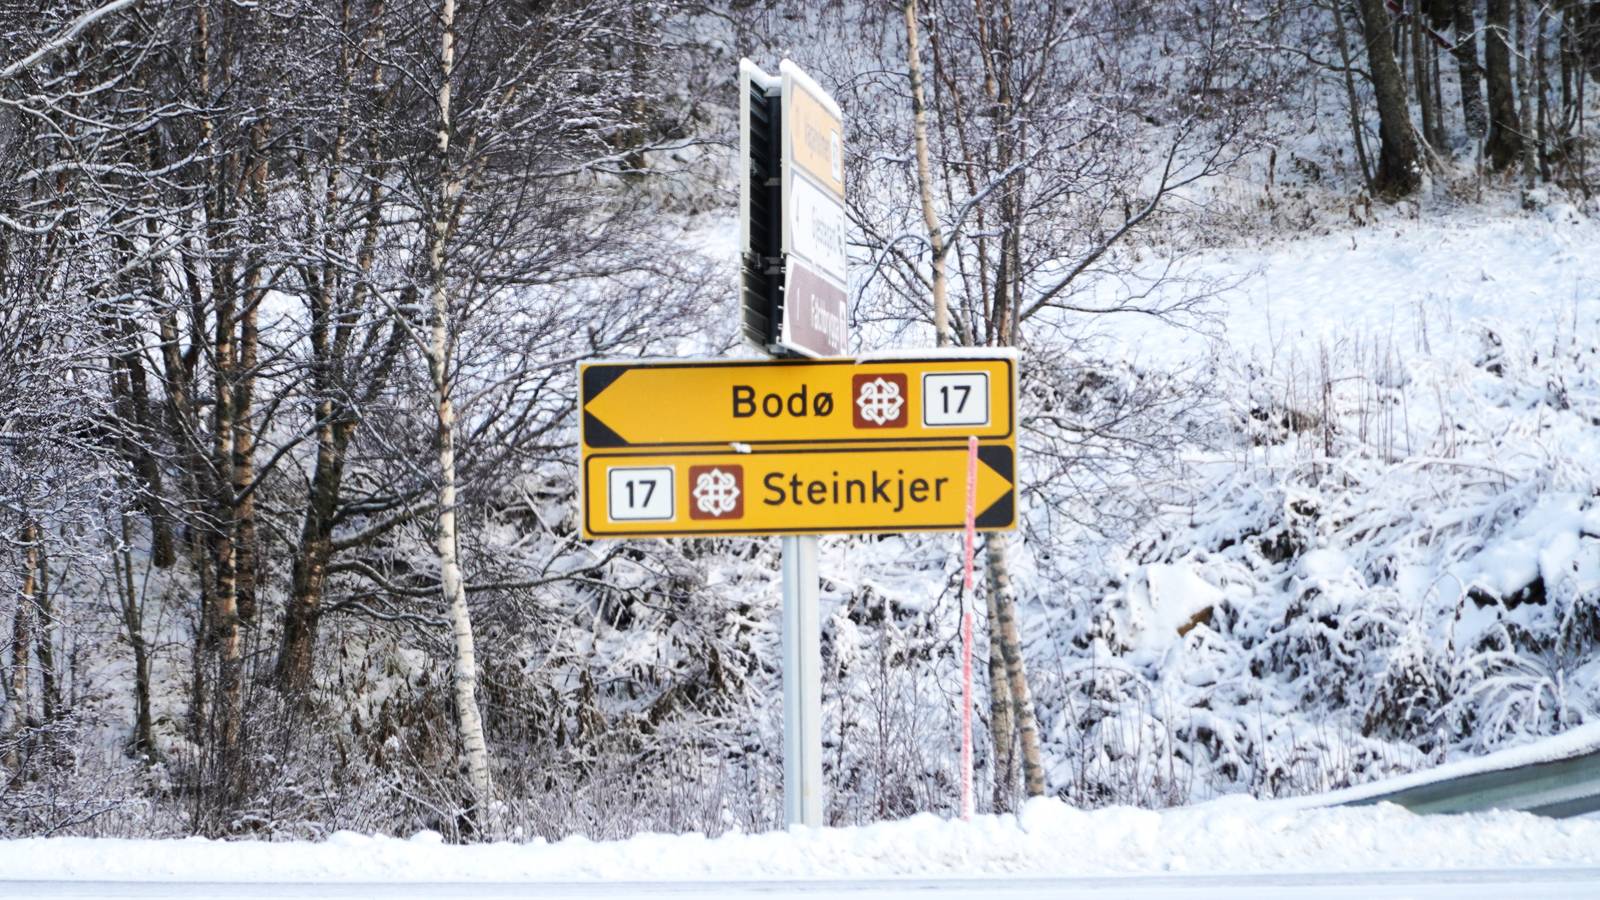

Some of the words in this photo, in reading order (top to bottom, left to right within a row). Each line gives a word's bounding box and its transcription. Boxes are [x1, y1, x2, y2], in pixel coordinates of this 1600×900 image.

[732, 384, 834, 418] Bodø
[940, 385, 971, 413] 17
[626, 480, 656, 508] 17
[763, 470, 949, 512] Steinkjer
